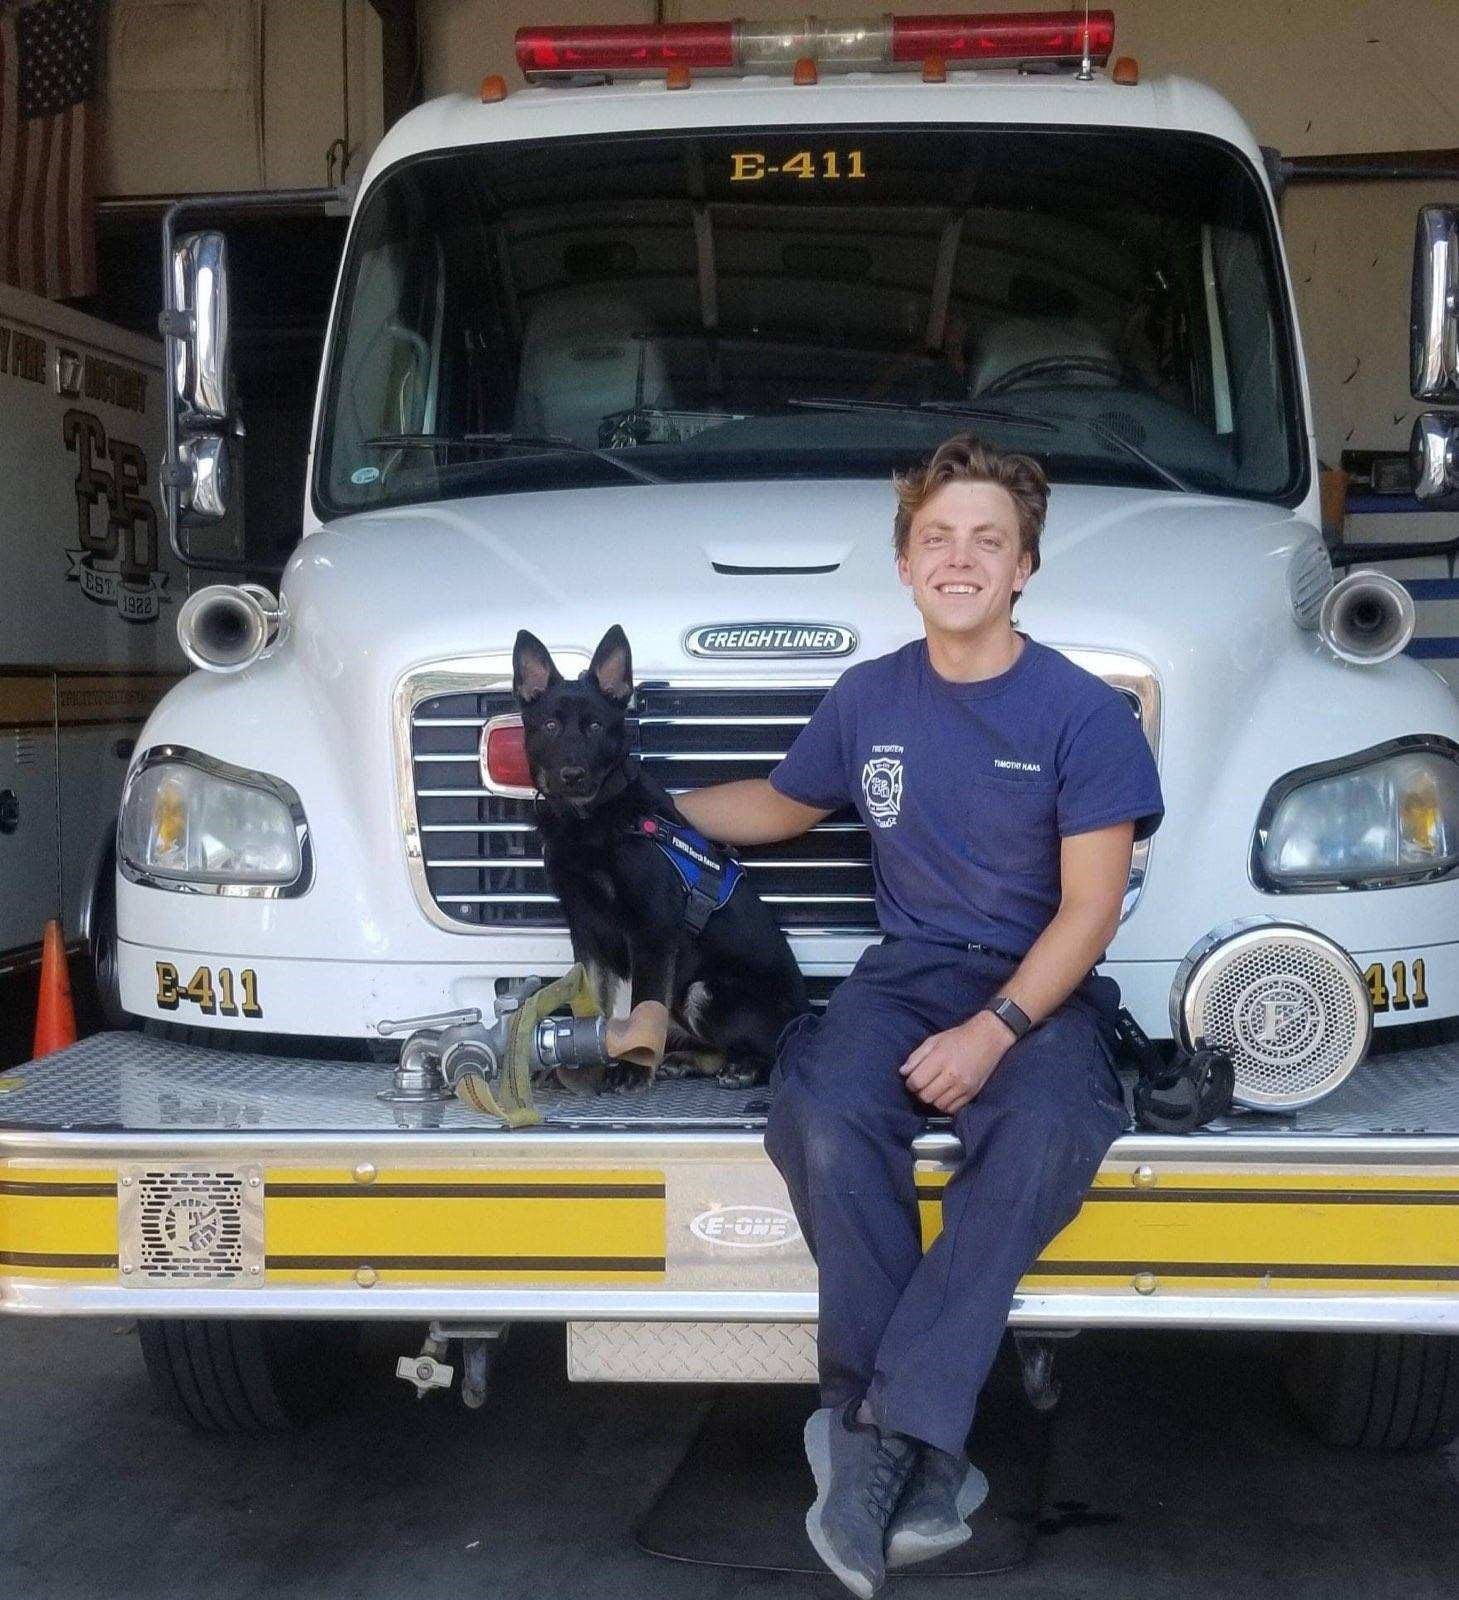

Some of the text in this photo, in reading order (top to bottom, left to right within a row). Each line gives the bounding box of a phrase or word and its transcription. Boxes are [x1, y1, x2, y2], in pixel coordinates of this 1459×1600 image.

[730, 150, 866, 181] E-411
[704, 630, 838, 648] FREIGHTLINER
[155, 961, 263, 1018] E-411
[705, 1217, 788, 1236] E-ONE
